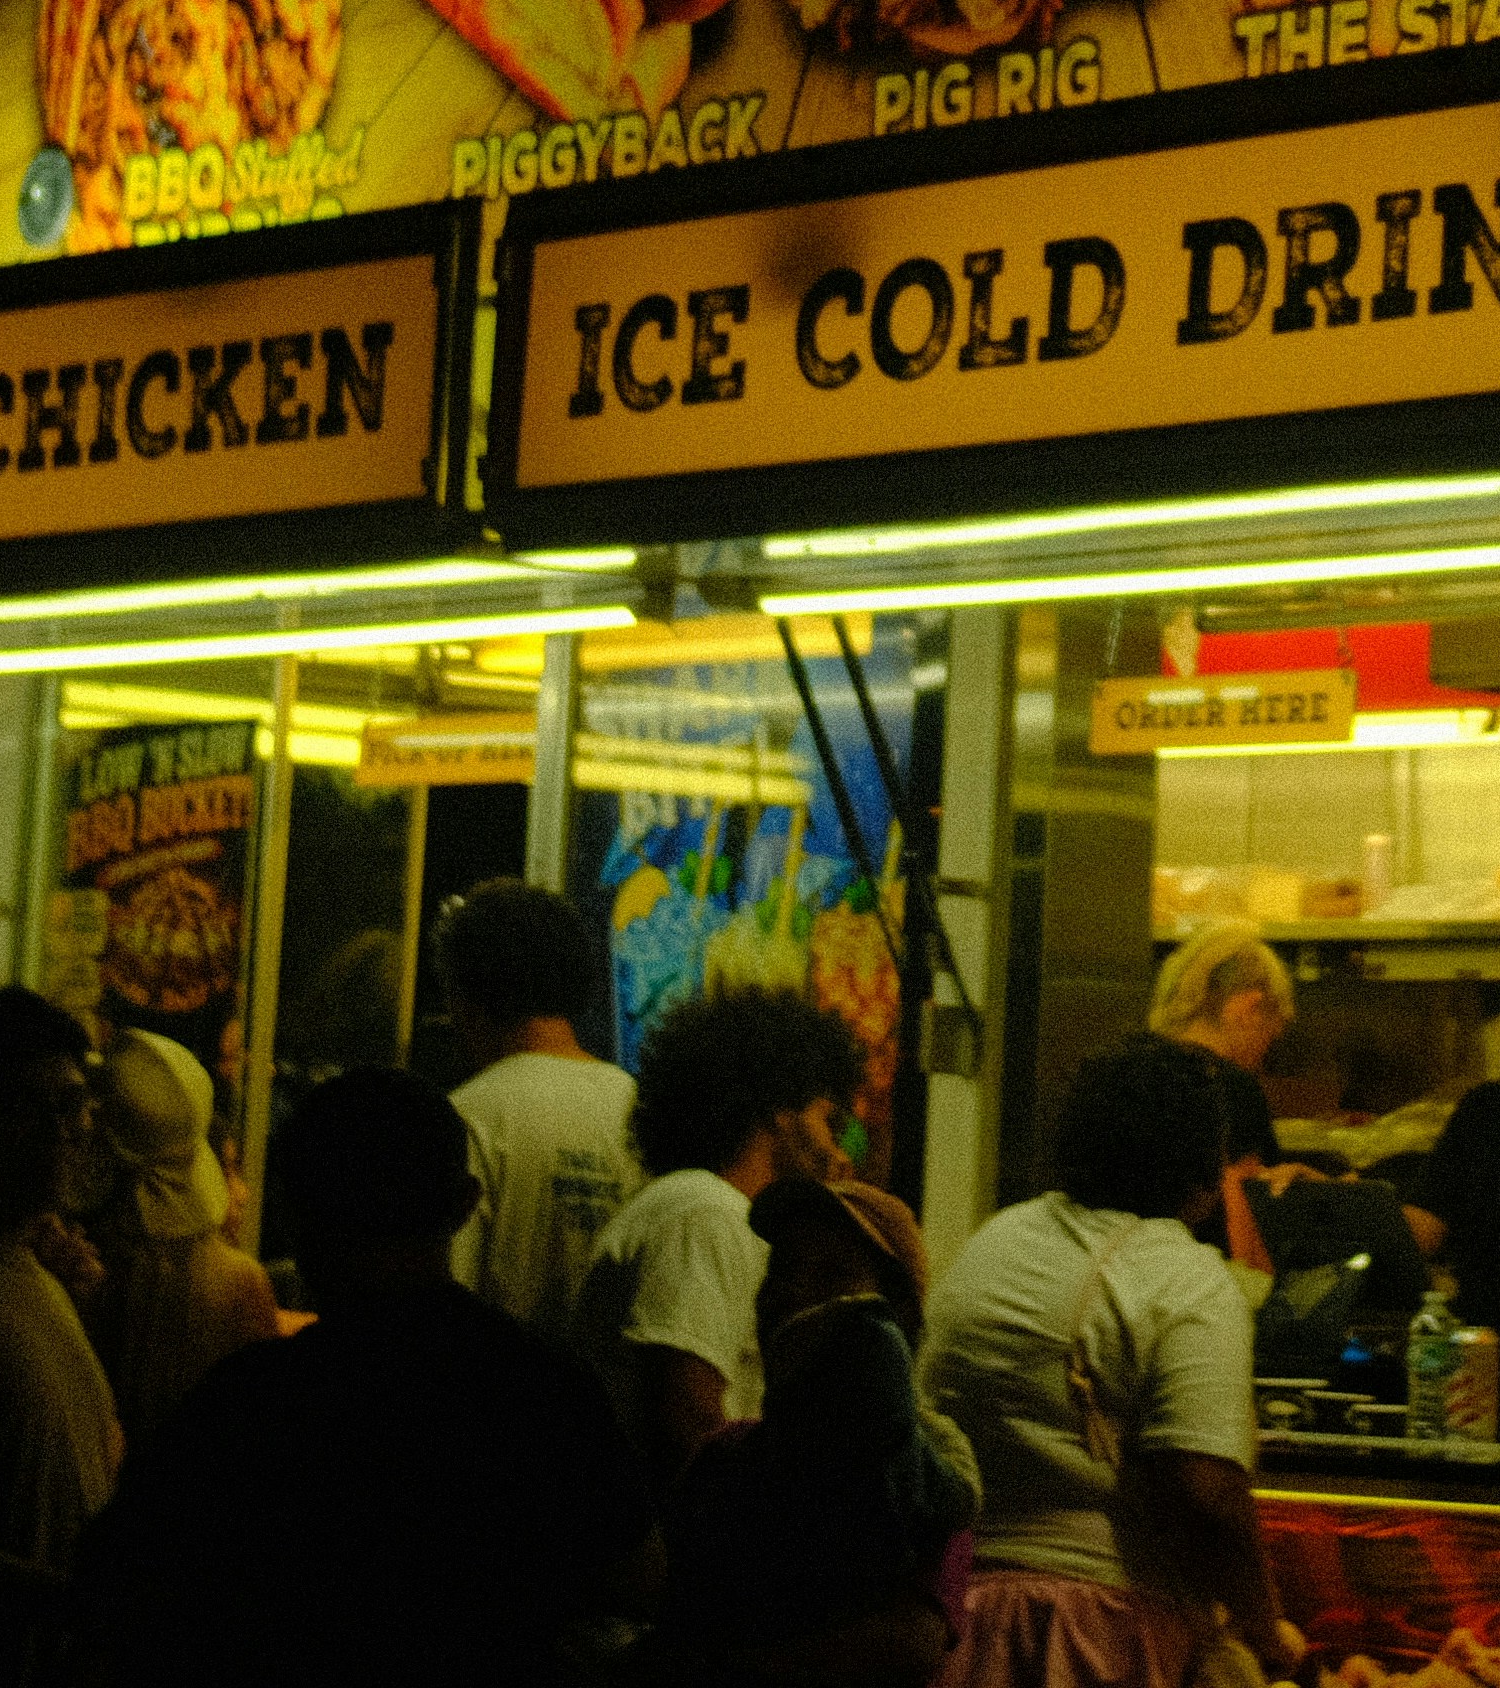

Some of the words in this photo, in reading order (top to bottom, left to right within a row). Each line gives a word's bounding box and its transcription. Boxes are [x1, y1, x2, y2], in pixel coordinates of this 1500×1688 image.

[871, 64, 976, 139] PIG
[996, 38, 1100, 115] RIG
[126, 145, 225, 218] BBQ
[450, 90, 767, 201] PIGGYBACK
[568, 284, 752, 419] ICE
[793, 233, 1127, 393] COLD
[1238, 690, 1329, 728] HERE
